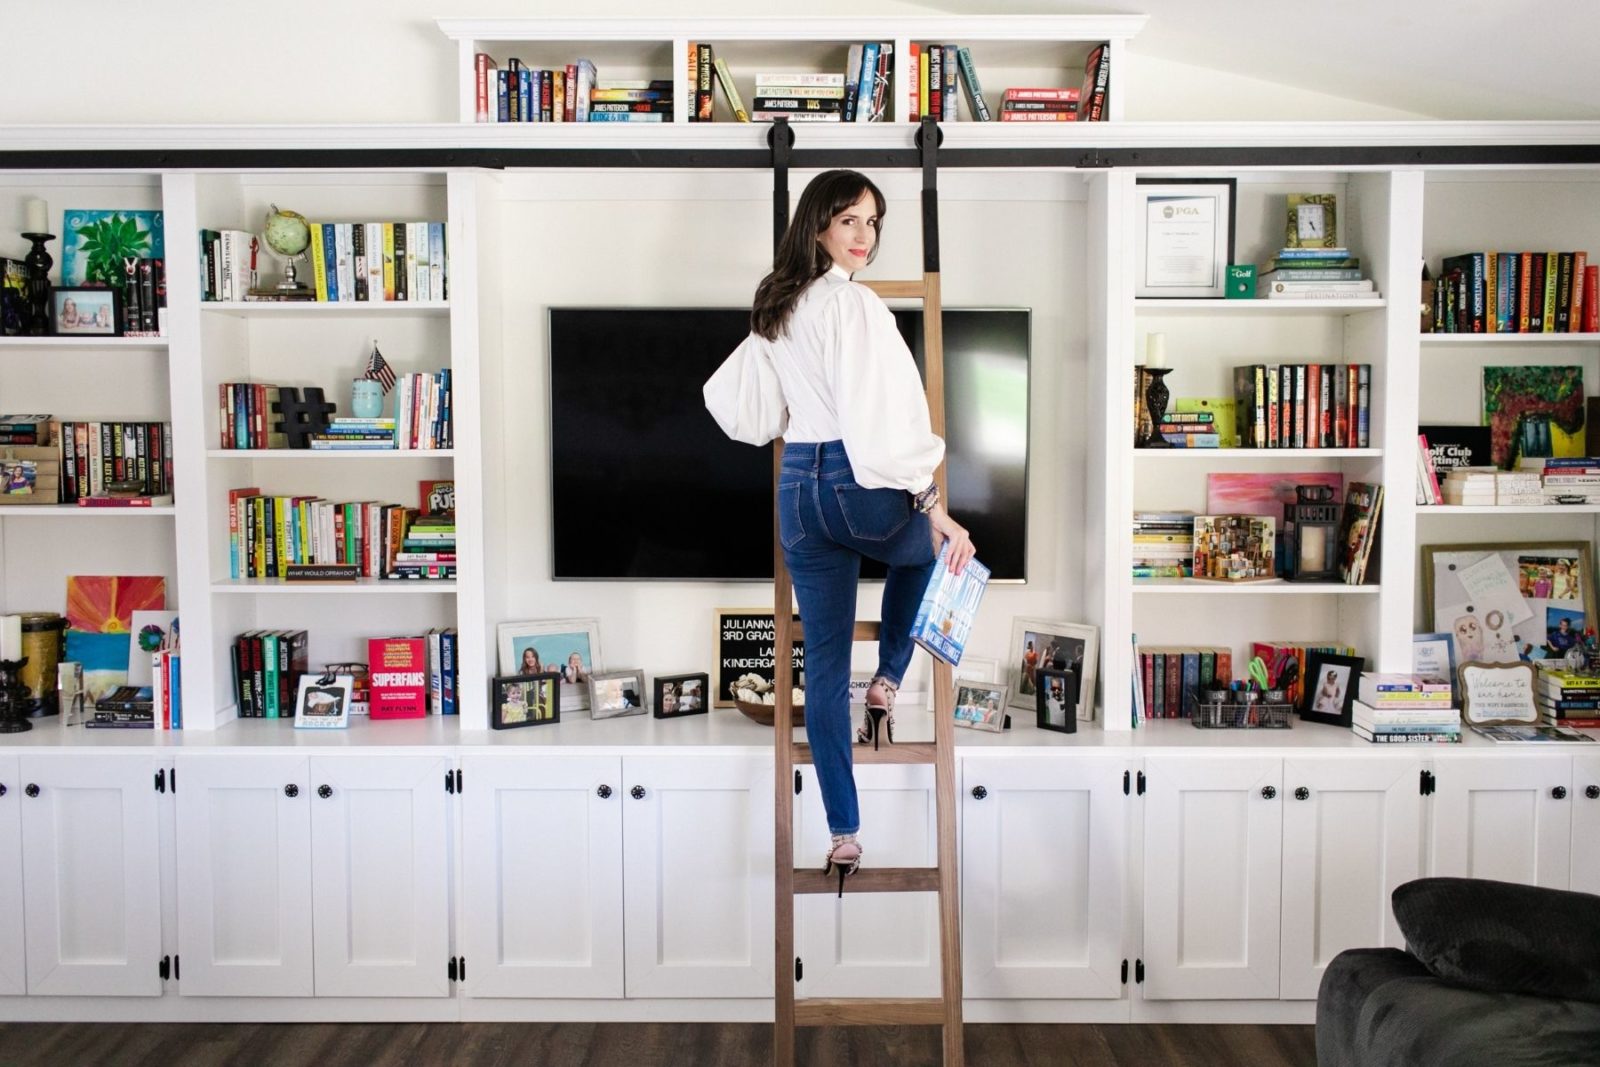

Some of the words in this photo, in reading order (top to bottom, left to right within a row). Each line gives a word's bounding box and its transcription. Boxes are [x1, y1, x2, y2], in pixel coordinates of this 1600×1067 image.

[807, 100, 820, 109] TOYS
[1176, 207, 1199, 215] PGA
[1473, 256, 1482, 277] JAMES
[1523, 256, 1531, 278] JAMES
[1548, 254, 1556, 275] JAMES
[1561, 256, 1570, 273] JAMES
[1576, 256, 1585, 273] JAMES
[1235, 270, 1252, 278] Golf
[1473, 277, 1482, 316] PATTERSON
[1523, 279, 1531, 316] PATTERSON
[1548, 276, 1556, 314] PATTERSON
[1561, 274, 1570, 307] PATTERSON
[1576, 274, 1585, 307] PATTERSON
[1532, 318, 1540, 326] 10
[1447, 447, 1472, 456] Club
[723, 620, 775, 629] JULIANNA
[723, 631, 744, 640] 3RD
[746, 631, 775, 640] GRAD
[723, 658, 804, 668] KINDERGAEN
[372, 672, 425, 687] SUPERFANS
[1471, 672, 1512, 689] Welcome
[1514, 678, 1527, 688] to
[243, 679, 251, 701] PRIVATE
[1376, 734, 1388, 743] THE
[1389, 734, 1406, 743] GOOD
[1408, 734, 1429, 743] SISTER
